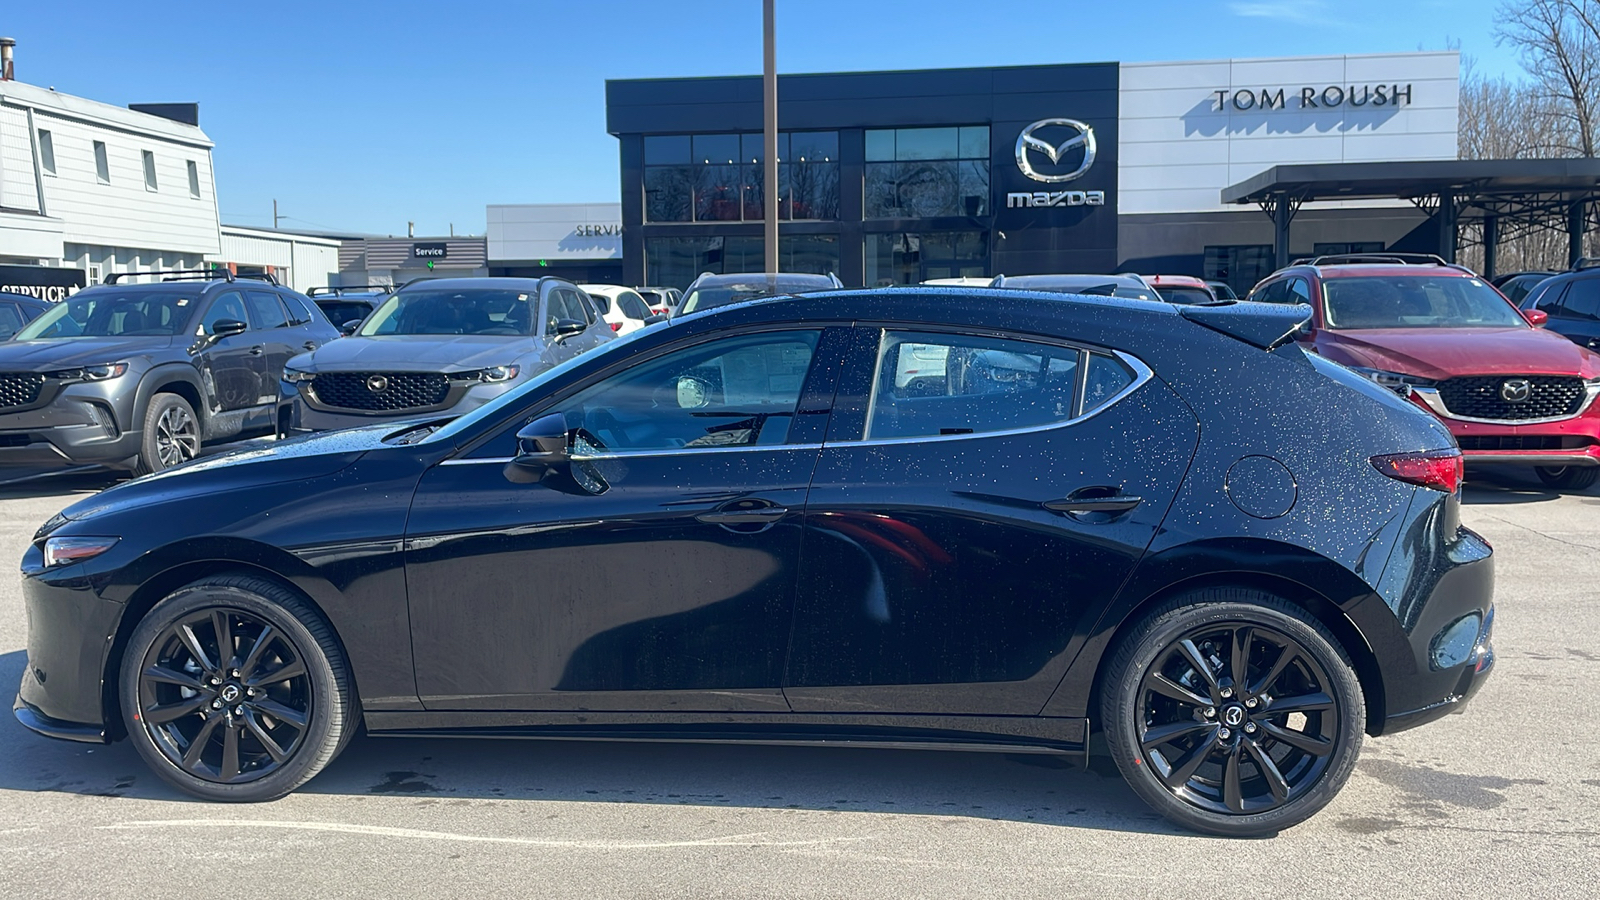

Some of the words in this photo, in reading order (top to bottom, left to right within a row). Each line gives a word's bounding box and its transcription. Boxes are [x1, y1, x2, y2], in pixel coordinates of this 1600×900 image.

[1214, 88, 1286, 111] TOM
[1301, 84, 1412, 109] ROUSH
[576, 224, 623, 237] SERVI
[415, 247, 443, 256] Service
